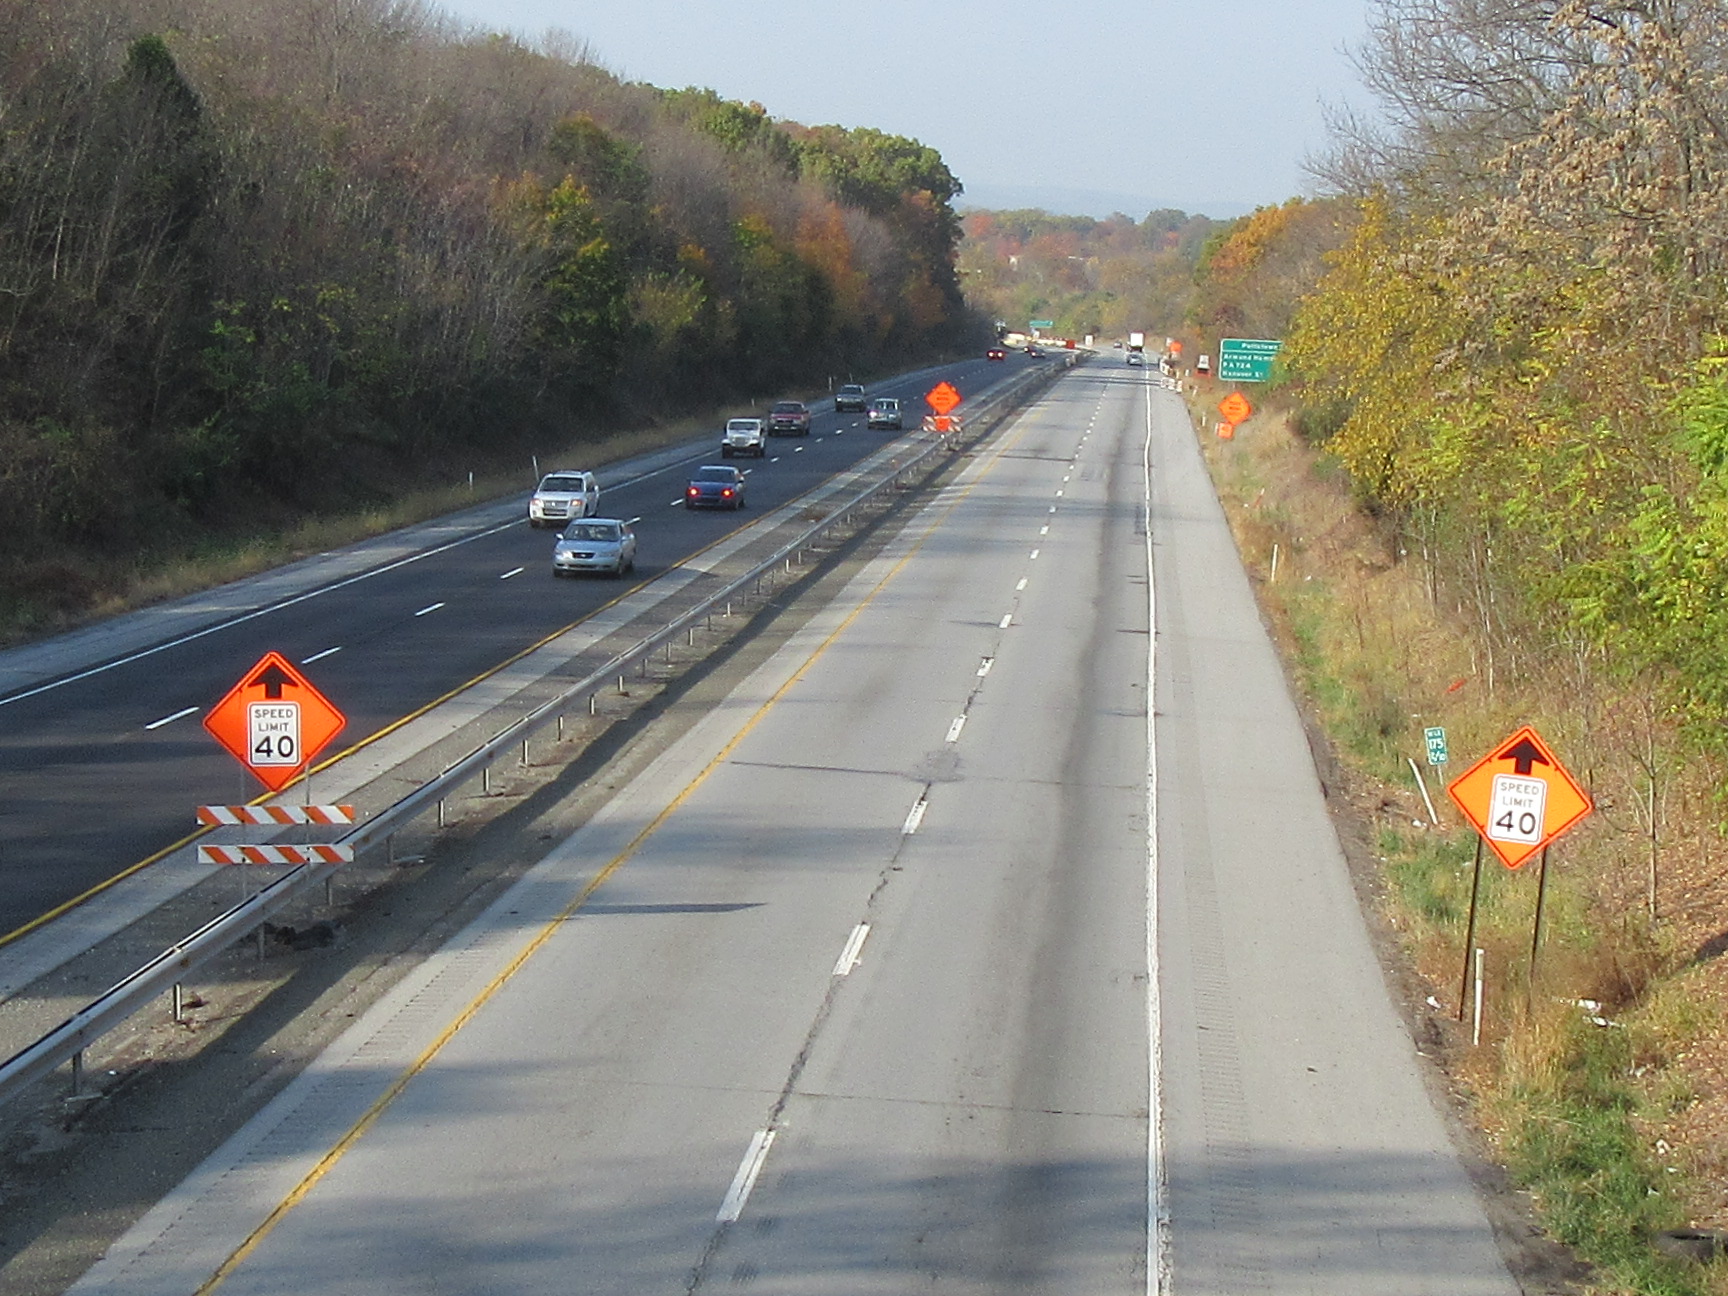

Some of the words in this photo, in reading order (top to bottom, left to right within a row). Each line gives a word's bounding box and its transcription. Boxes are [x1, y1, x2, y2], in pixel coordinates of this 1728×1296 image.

[254, 708, 294, 719] SPEED
[258, 722, 289, 732] LIMIT
[254, 735, 294, 758] 40
[1428, 738, 1444, 750] 175
[1500, 781, 1539, 795] SPEED
[1502, 795, 1533, 808] LIMIT
[1495, 809, 1536, 835] 40
